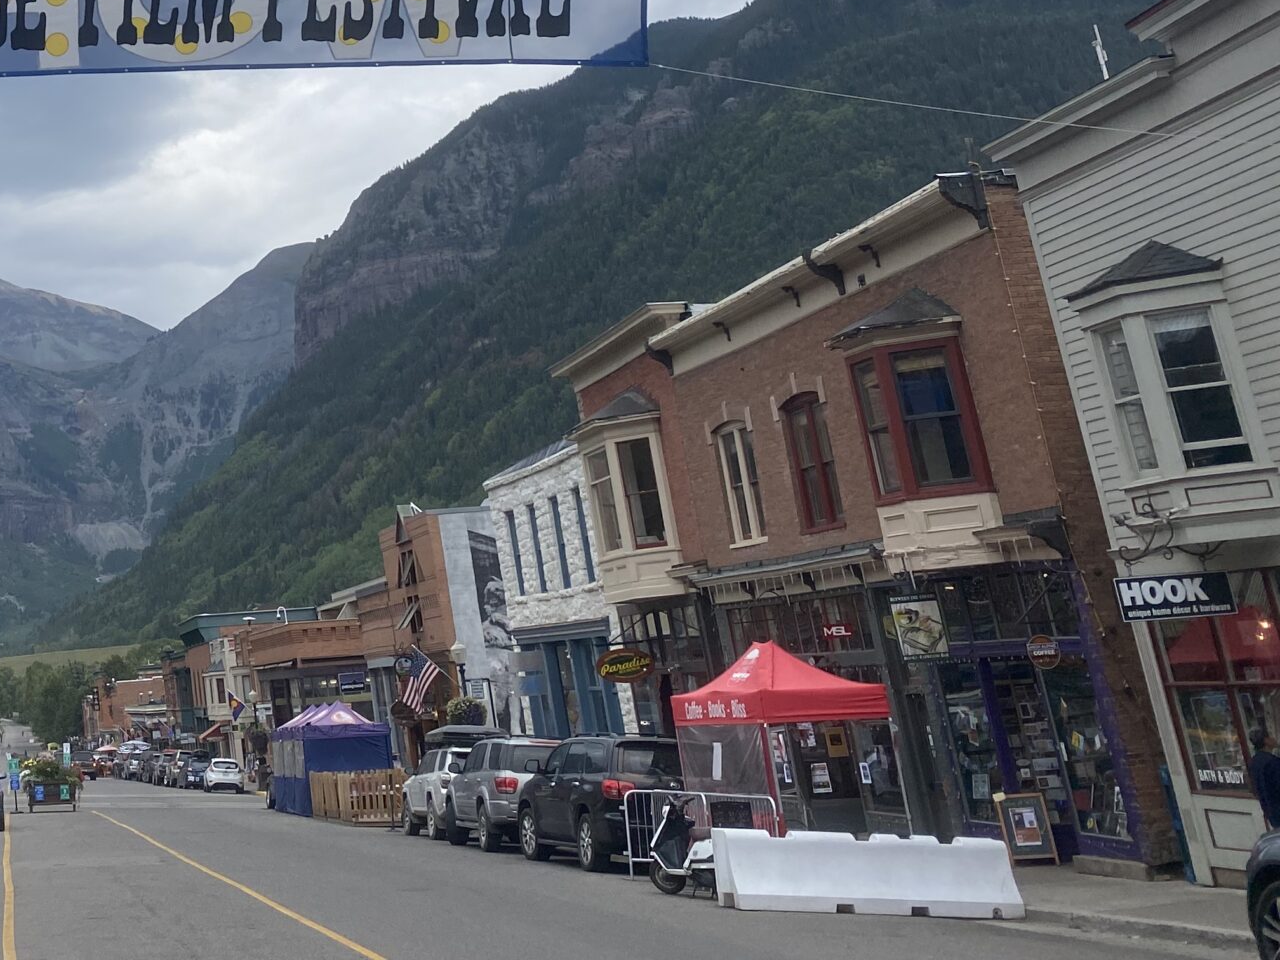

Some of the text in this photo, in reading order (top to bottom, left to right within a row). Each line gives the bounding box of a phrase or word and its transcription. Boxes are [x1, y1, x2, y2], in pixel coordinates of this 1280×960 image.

[1119, 578, 1210, 606] HOOK
[1128, 609, 1151, 618] unique
[1152, 607, 1171, 616] home
[1193, 605, 1198, 613] &
[1200, 604, 1231, 612] hardware
[601, 656, 651, 676] Paradise
[685, 700, 703, 719] Coffee
[708, 699, 726, 718] Books
[731, 699, 747, 718] Bliss
[1198, 769, 1217, 782] BATH
[1224, 770, 1244, 784] BODY
